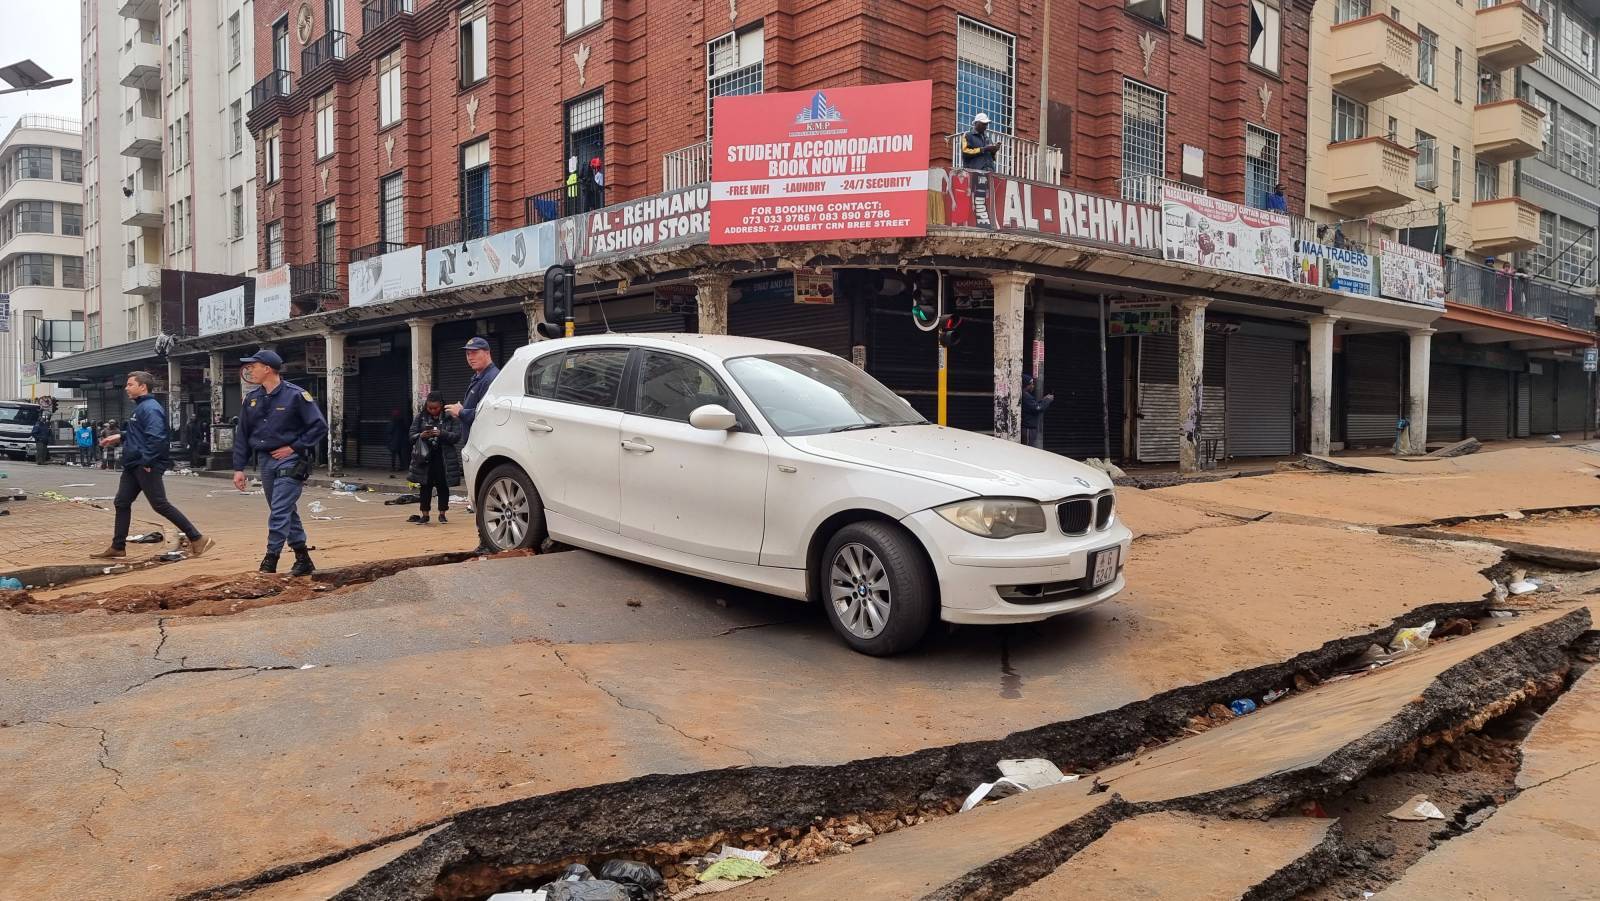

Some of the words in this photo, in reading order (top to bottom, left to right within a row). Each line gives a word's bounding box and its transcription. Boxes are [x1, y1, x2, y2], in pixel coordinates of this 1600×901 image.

[806, 122, 830, 131] K.M.P
[727, 142, 791, 162] STUDENT
[793, 134, 913, 159] ACCOMODATION
[768, 158, 808, 177] BOOK
[812, 156, 847, 175] NOW
[750, 184, 770, 195] WIFI
[866, 177, 912, 189] SECURITY
[592, 212, 611, 233] AL
[624, 188, 709, 226] REHMANU
[751, 207, 772, 215] FOR
[775, 204, 824, 214] BOOKING
[827, 202, 882, 212] CONTACT:
[1003, 180, 1040, 231] AL
[724, 225, 767, 234] ADDRESS:
[769, 224, 780, 232] 72
[782, 222, 822, 232] JOUBERT
[825, 222, 844, 230] CRN
[847, 220, 871, 229] BREE
[874, 218, 911, 228] STREET
[743, 216, 760, 225] 073
[764, 215, 782, 224] 033
[785, 213, 810, 223] 9786
[819, 212, 838, 221] 083
[841, 211, 861, 220] 890
[864, 209, 891, 219] 8786
[589, 223, 654, 255] FASHION
[658, 211, 711, 240] STORE
[1302, 241, 1323, 258] MAA
[1326, 247, 1368, 267] TRADERS
